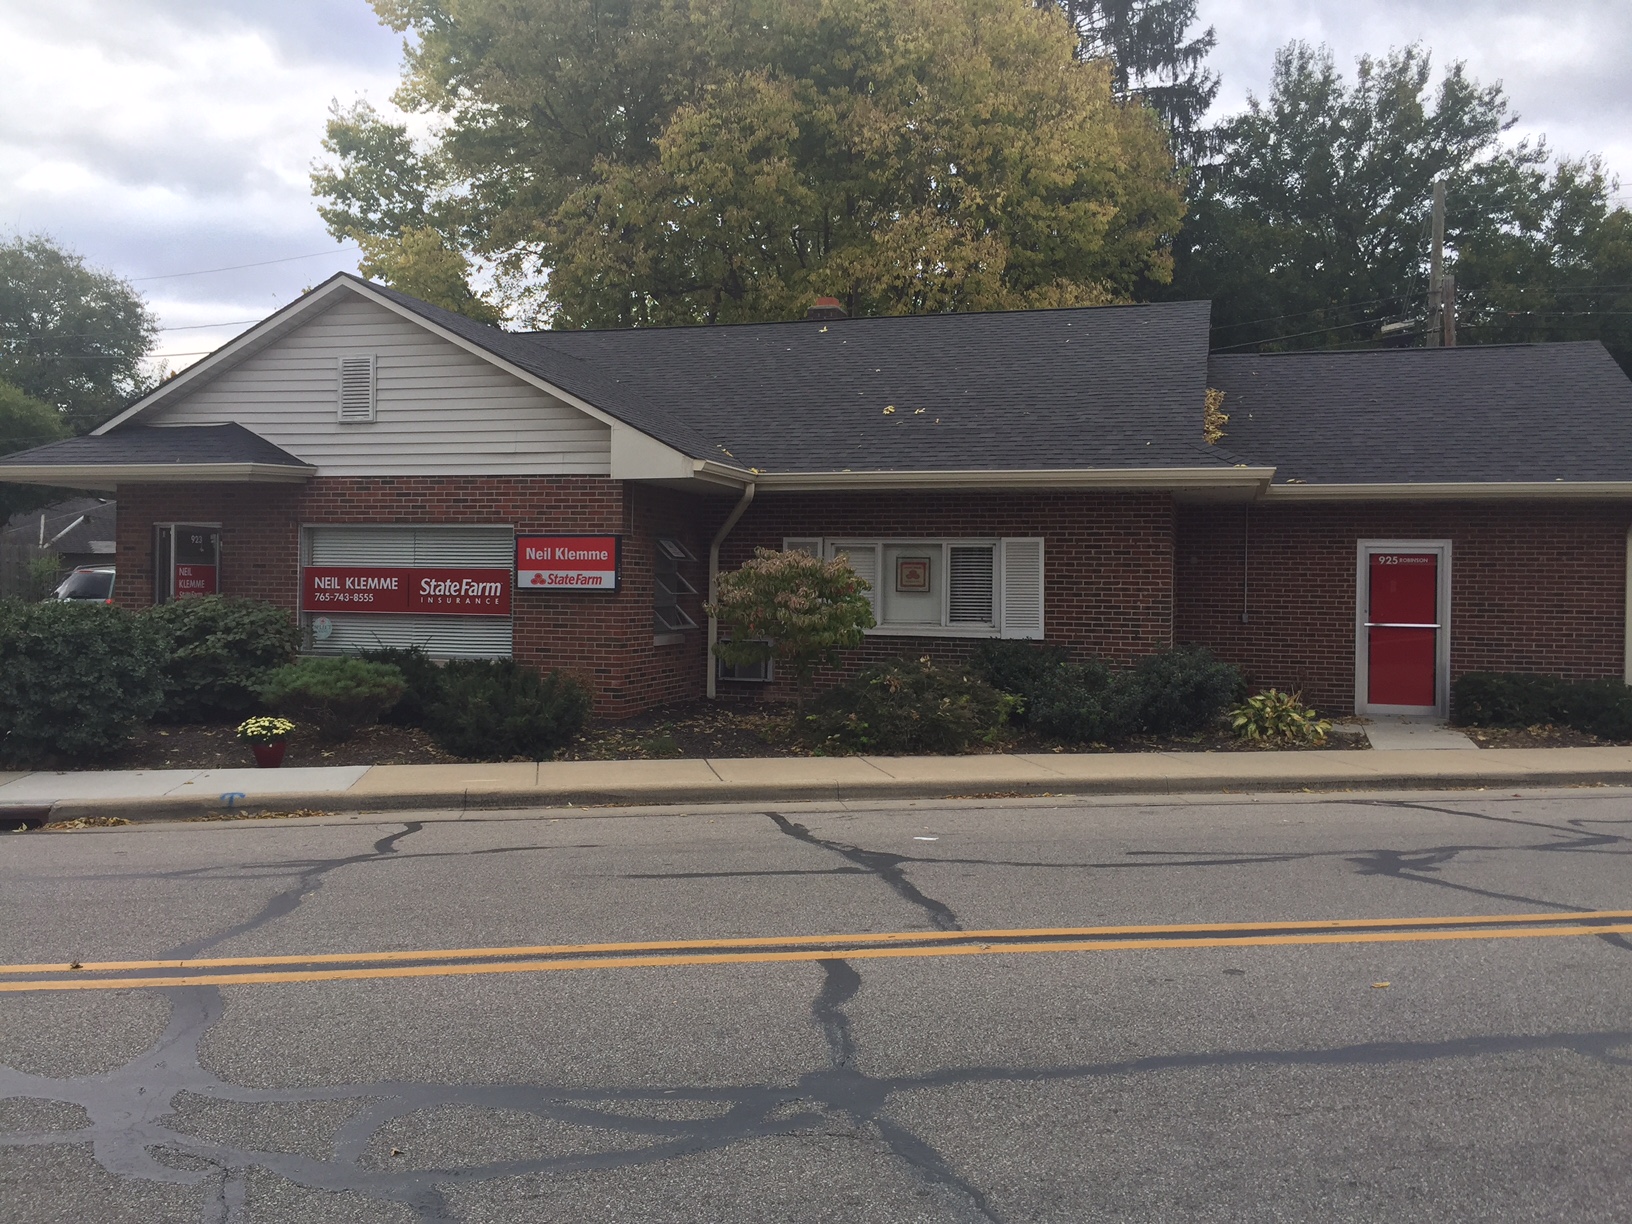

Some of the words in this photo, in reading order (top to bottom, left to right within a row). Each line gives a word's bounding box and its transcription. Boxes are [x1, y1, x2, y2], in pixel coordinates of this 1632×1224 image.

[191, 535, 203, 544] 923
[526, 547, 551, 560] Neil
[555, 547, 608, 560] Klemme
[1379, 556, 1398, 565] 925
[178, 567, 192, 576] NEIL
[178, 579, 205, 588] KLEMME
[314, 576, 341, 589] NEIL
[345, 577, 399, 590] KLEMME
[314, 592, 374, 602] 765-743-8555
[420, 597, 499, 605] INSURANCE
